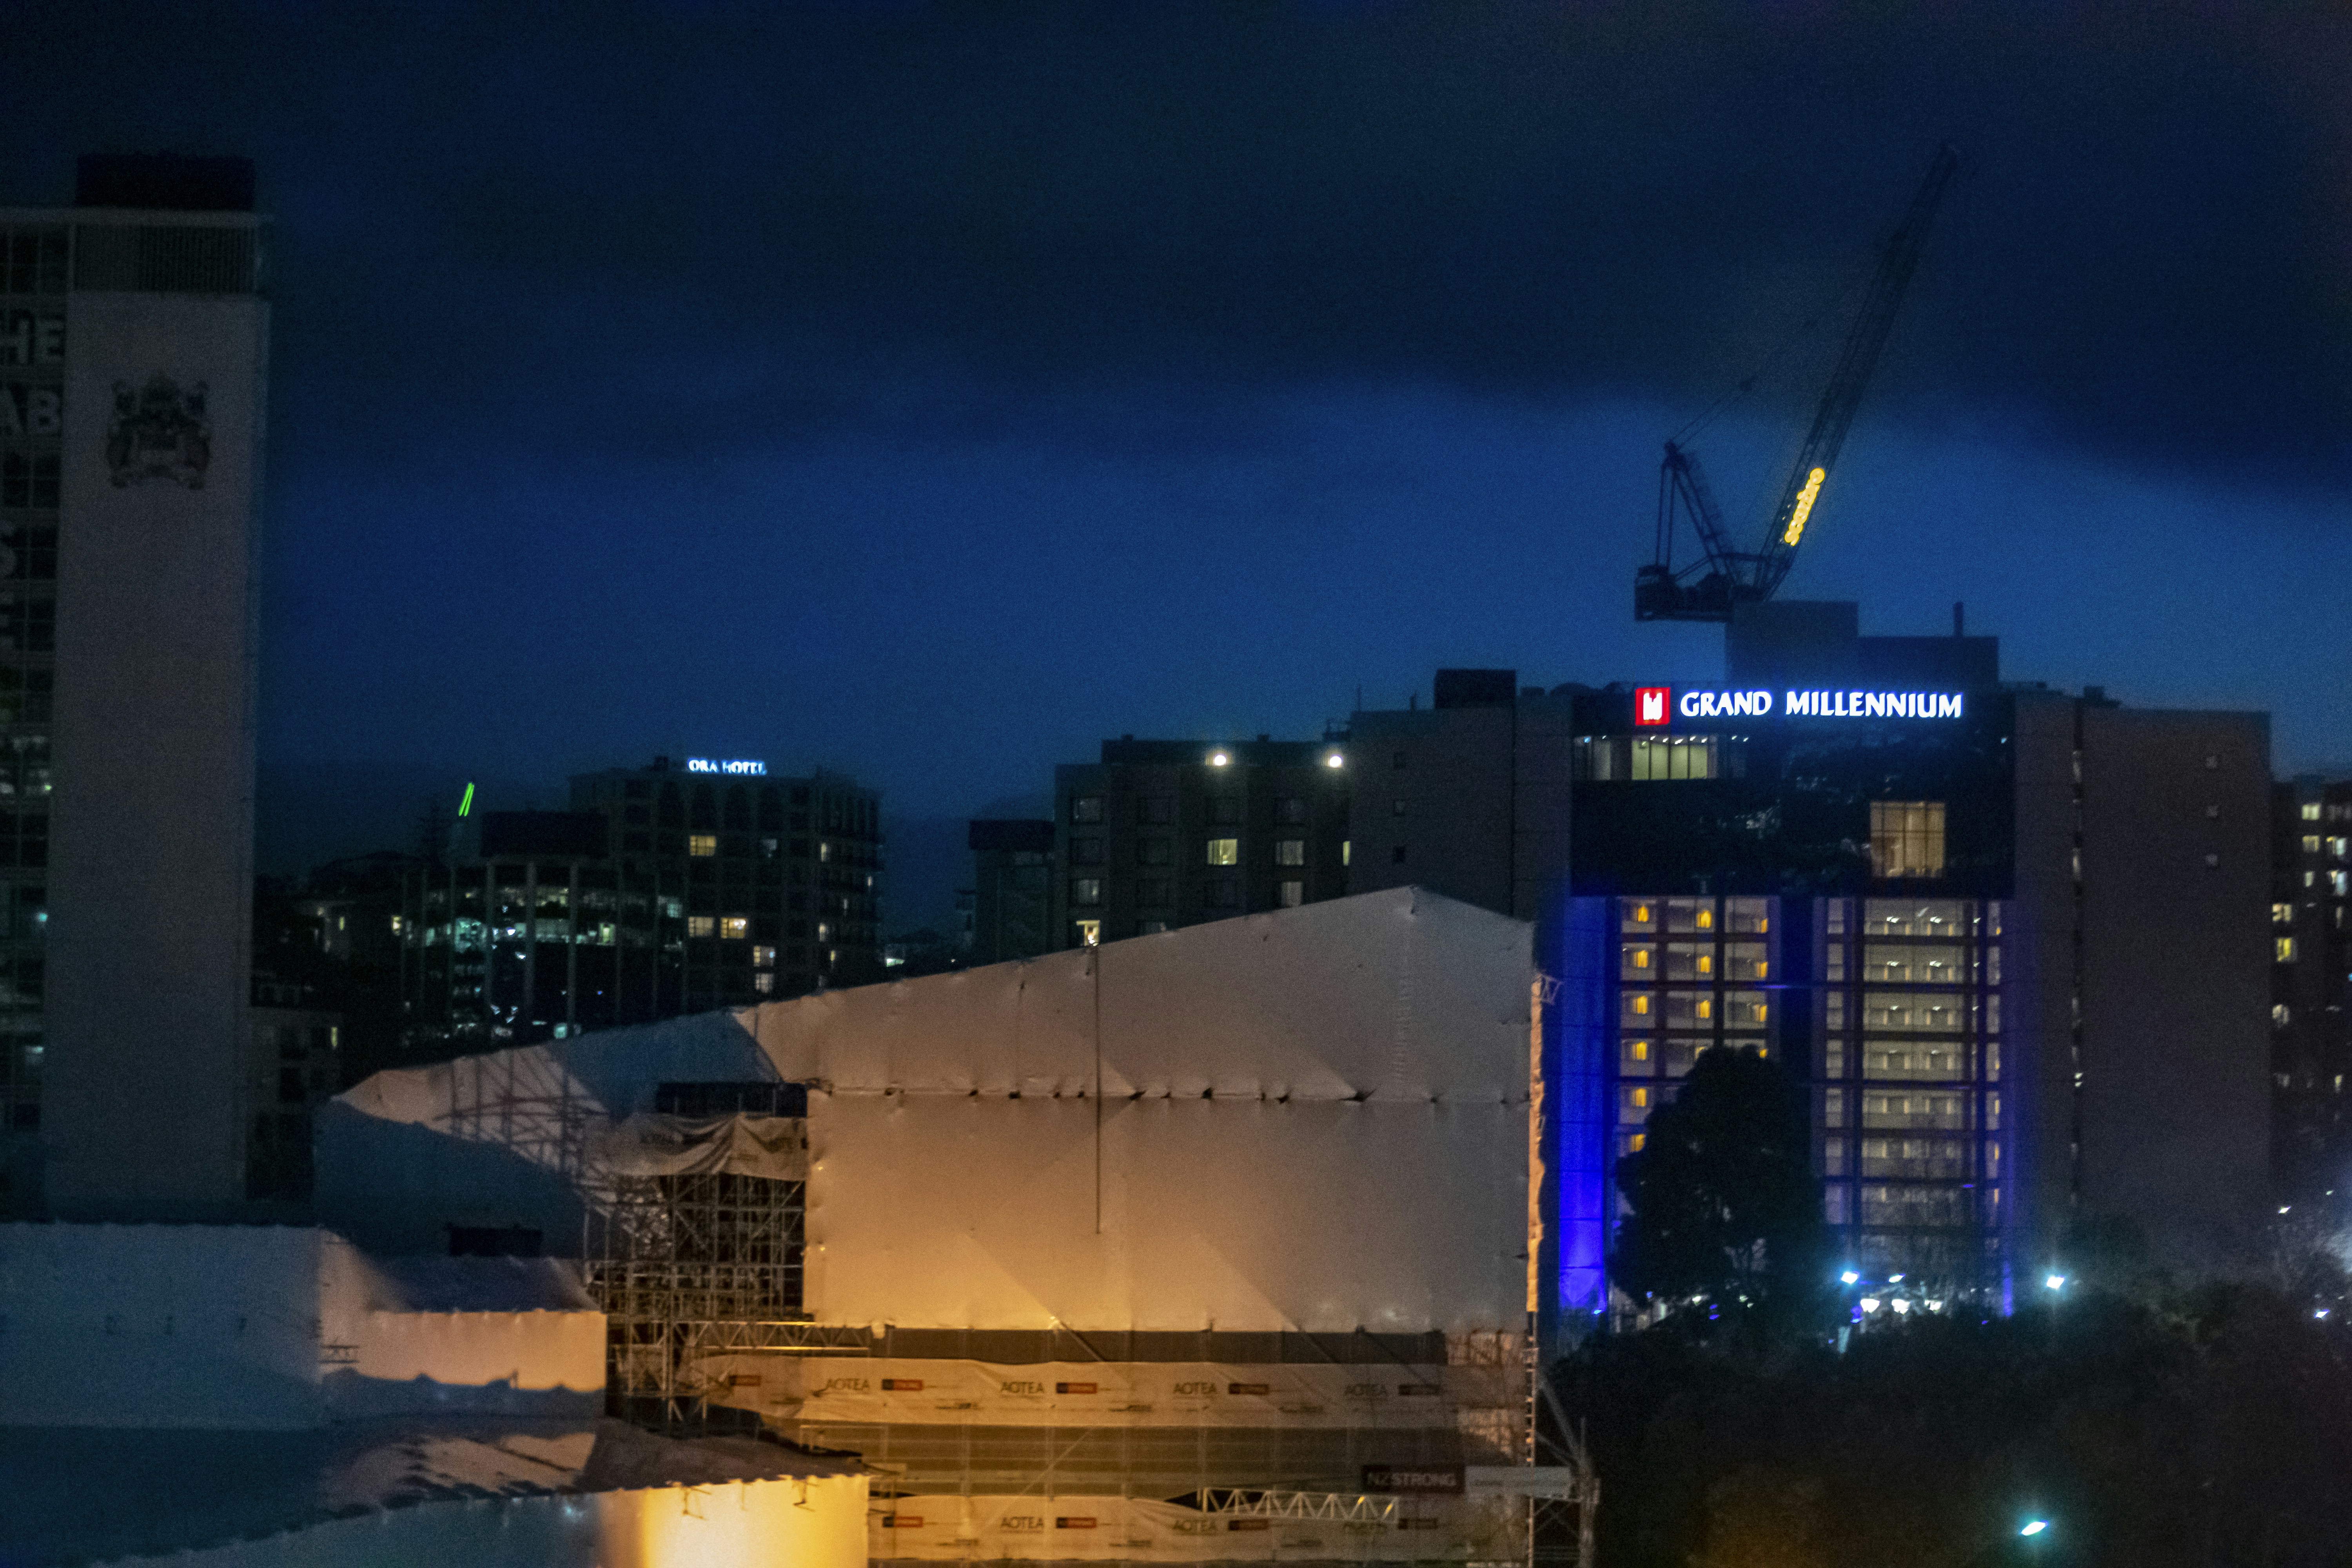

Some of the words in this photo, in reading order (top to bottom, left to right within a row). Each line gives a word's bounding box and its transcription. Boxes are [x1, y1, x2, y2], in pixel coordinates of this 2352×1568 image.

[1680, 691, 1772, 717] GRAND
[1786, 690, 1962, 718] MILLENNIUM
[688, 759, 719, 773] ORA
[826, 1378, 869, 1390] AOTEA
[1001, 1381, 1044, 1393] AOTEA
[1391, 1472, 1457, 1486] STRONG
